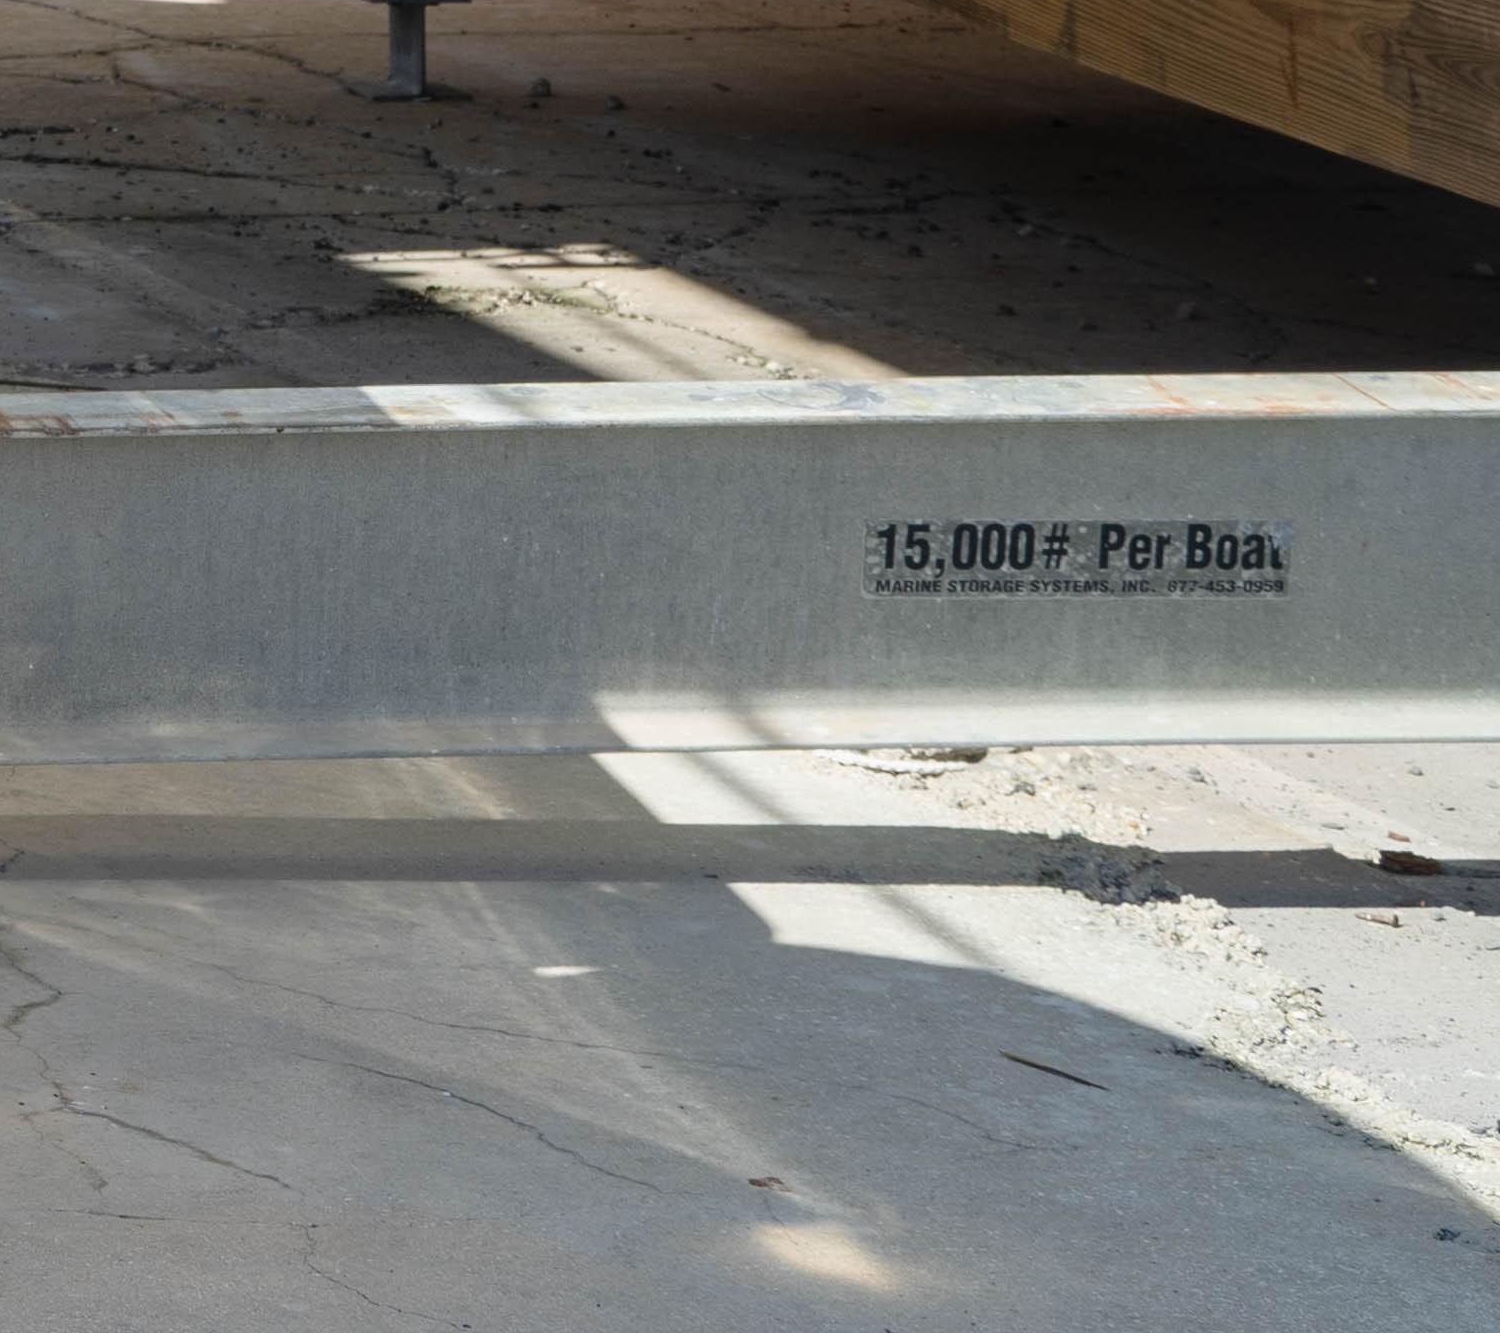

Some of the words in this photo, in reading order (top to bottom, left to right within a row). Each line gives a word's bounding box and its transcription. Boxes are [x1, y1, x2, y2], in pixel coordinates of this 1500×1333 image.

[1098, 523, 1172, 571] Per
[875, 581, 942, 594] MARINE
[947, 581, 1024, 594] STORAGE
[1029, 581, 1115, 595] SYSTEMS,
[1121, 581, 1157, 594] INC.
